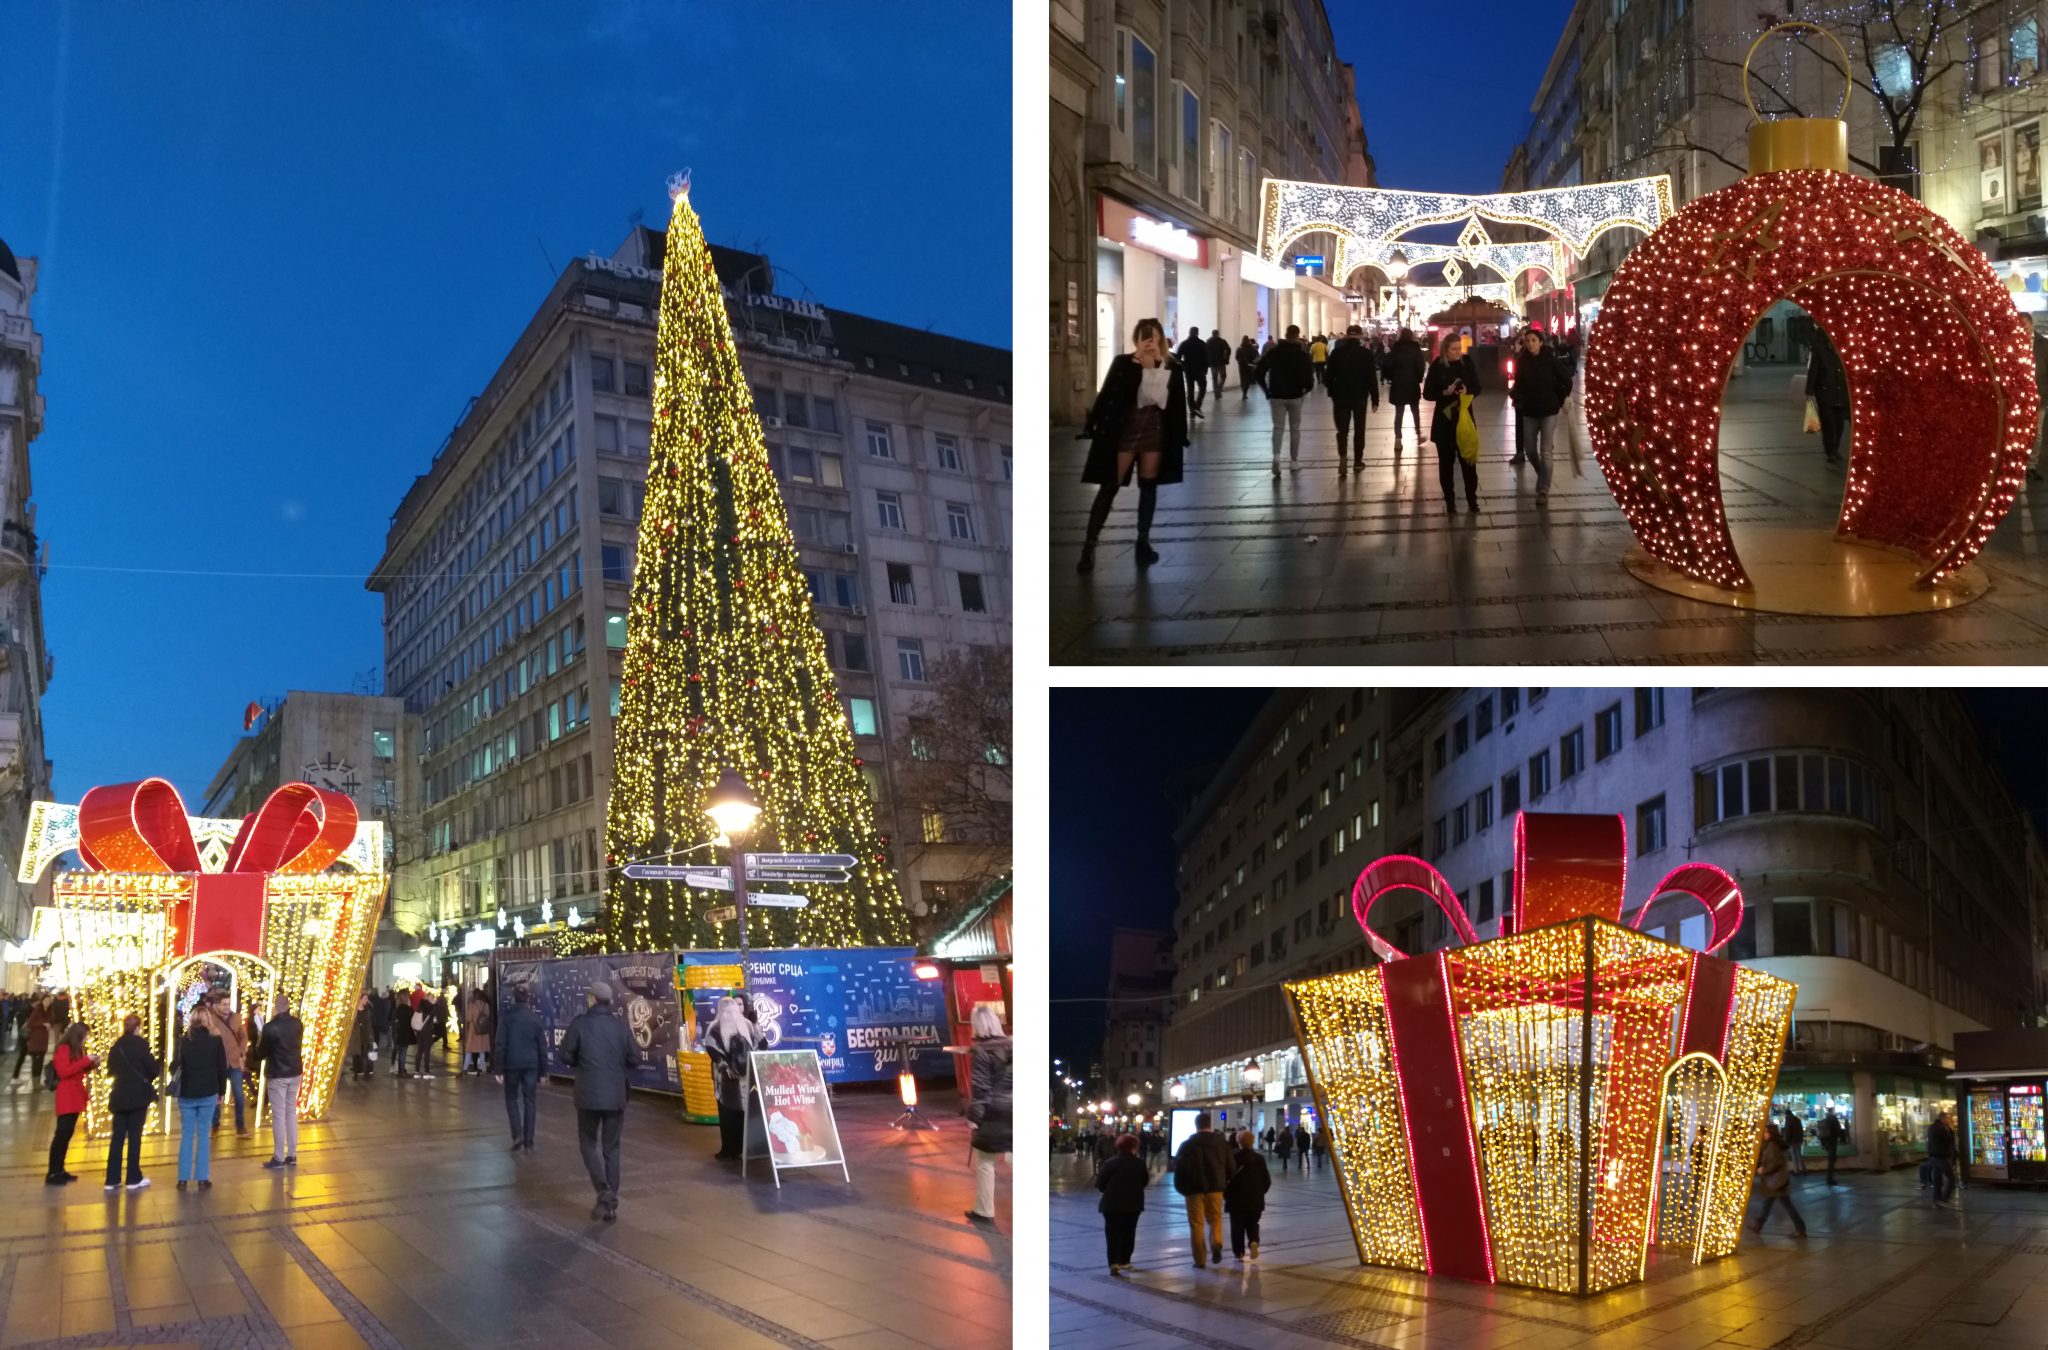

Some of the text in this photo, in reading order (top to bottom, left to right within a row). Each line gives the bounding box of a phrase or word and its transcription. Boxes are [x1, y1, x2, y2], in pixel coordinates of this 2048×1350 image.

[761, 856, 783, 864] Belgrade
[749, 962, 776, 975] РЕНОГ
[779, 963, 803, 977] СРЦА
[847, 1025, 940, 1049] БЕОГРАДСКА
[818, 1056, 845, 1070] еоград
[765, 1083, 821, 1096] Mulled Wine
[774, 1095, 816, 1106] Hot Wine
